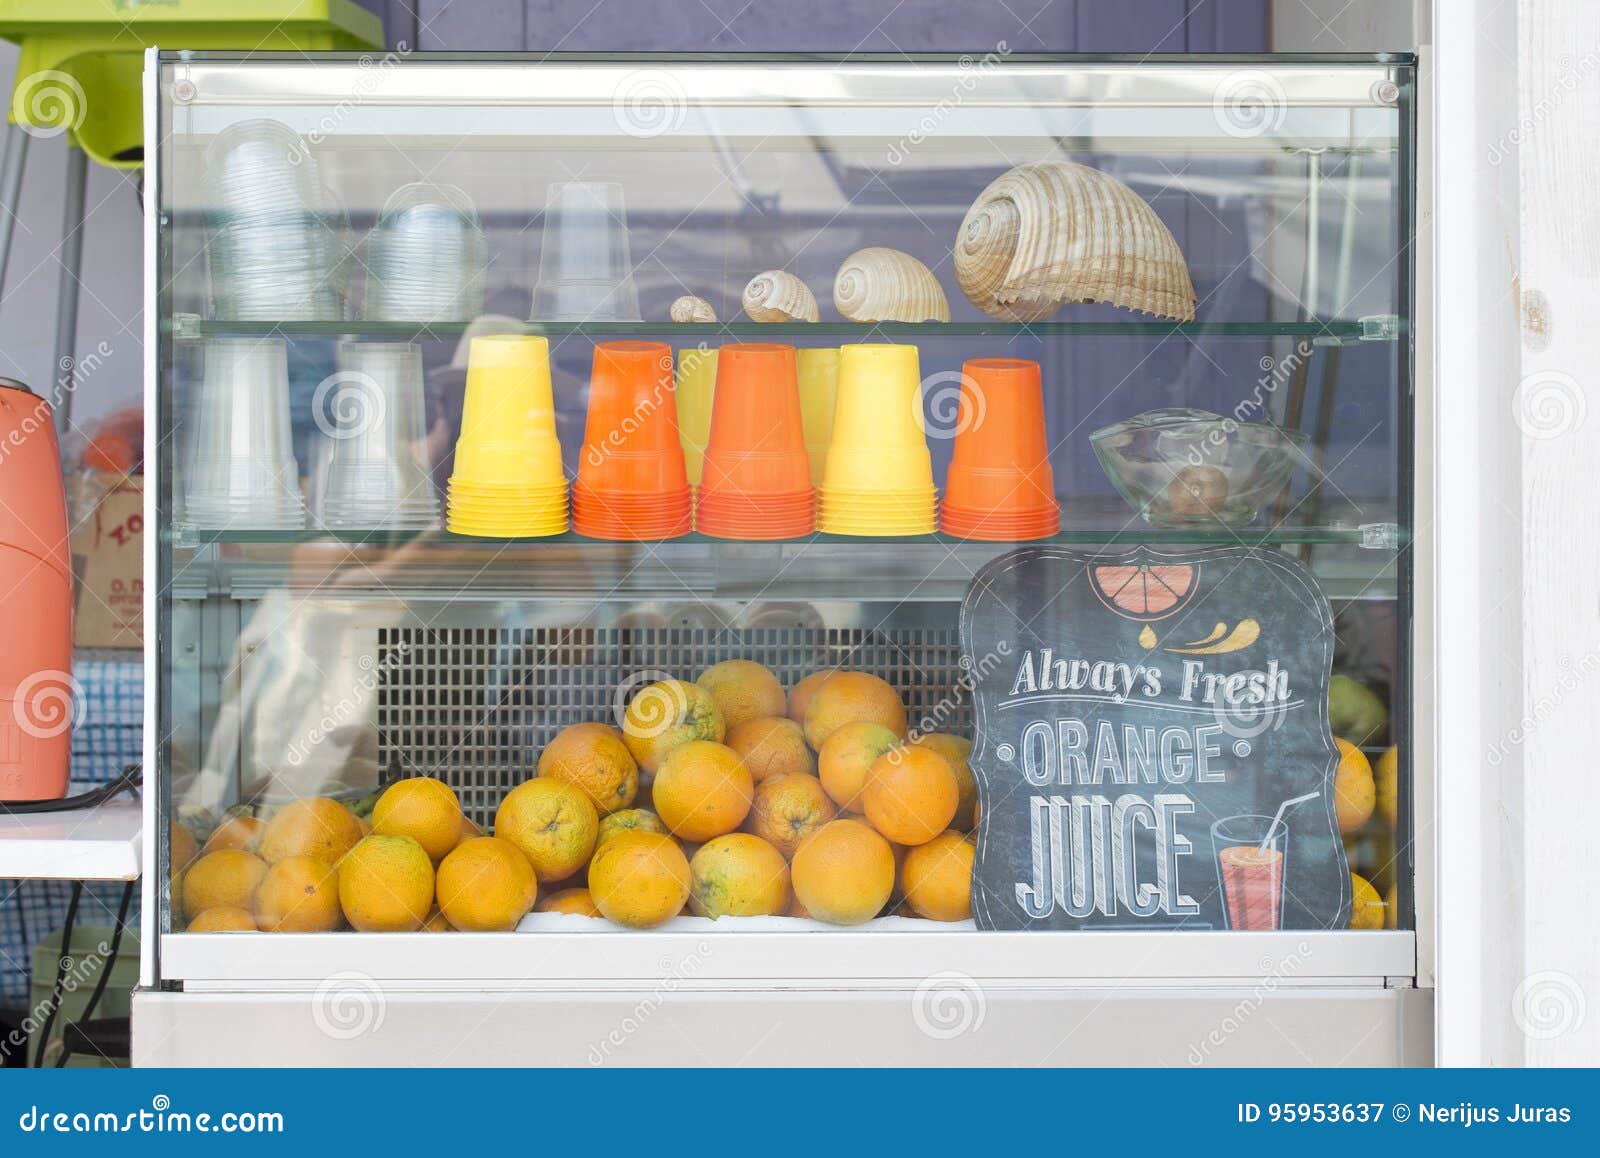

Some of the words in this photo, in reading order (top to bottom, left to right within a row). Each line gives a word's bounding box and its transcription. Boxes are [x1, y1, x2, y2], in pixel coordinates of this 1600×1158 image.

[1009, 648, 1162, 704] Always
[1178, 658, 1292, 703] Fresh
[1021, 718, 1226, 786] ORANGE
[1015, 794, 1200, 918] JUICE
